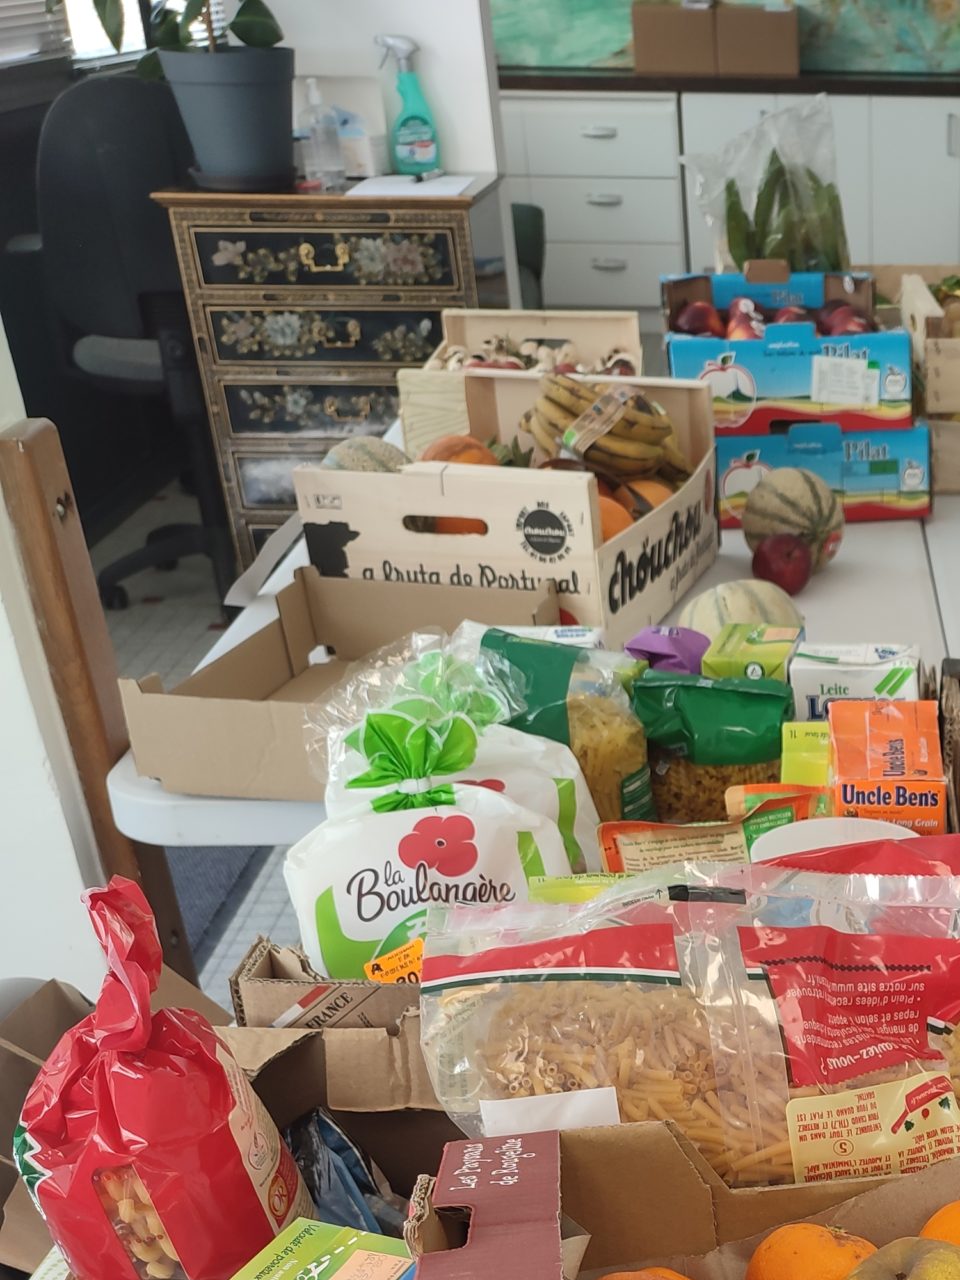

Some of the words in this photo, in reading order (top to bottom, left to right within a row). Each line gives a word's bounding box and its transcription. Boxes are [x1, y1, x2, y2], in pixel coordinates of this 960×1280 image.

[843, 440, 890, 460] Pilat
[820, 684, 849, 695] Leite
[842, 784, 890, 805] Uncle
[895, 785, 939, 807] Ben's
[915, 819, 938, 827] Grain
[383, 860, 406, 886] la
[346, 862, 517, 923] Boulangère
[857, 983, 876, 994] site
[879, 982, 907, 994] notre
[909, 982, 925, 993] sur
[855, 995, 888, 1006] d'idées
[304, 992, 354, 1029] FRANCE
[893, 1009, 919, 1021] repas
[854, 1014, 878, 1024] selon
[881, 1013, 891, 1025] et
[908, 1023, 919, 1034] de
[820, 1058, 827, 1075] ?
[809, 1111, 824, 1120] PLAT
[826, 1110, 833, 1118] LE
[836, 1106, 854, 1116] QUAND
[796, 1113, 806, 1122] EST
[851, 1115, 867, 1125] CHAUD
[822, 1121, 828, 1130] ET
[798, 1134, 808, 1142] UN
[809, 1132, 826, 1141] DANS
[829, 1130, 843, 1139] TOUT
[846, 1128, 853, 1137] LE
[839, 1142, 848, 1153] 5
[859, 1156, 882, 1166] AJOUTEZ
[834, 1168, 851, 1179] SAUCE
[852, 1168, 860, 1176] LA
[861, 1166, 869, 1175] DE
[871, 1164, 884, 1173] TOUT
[255, 1253, 284, 1280] poireaux
